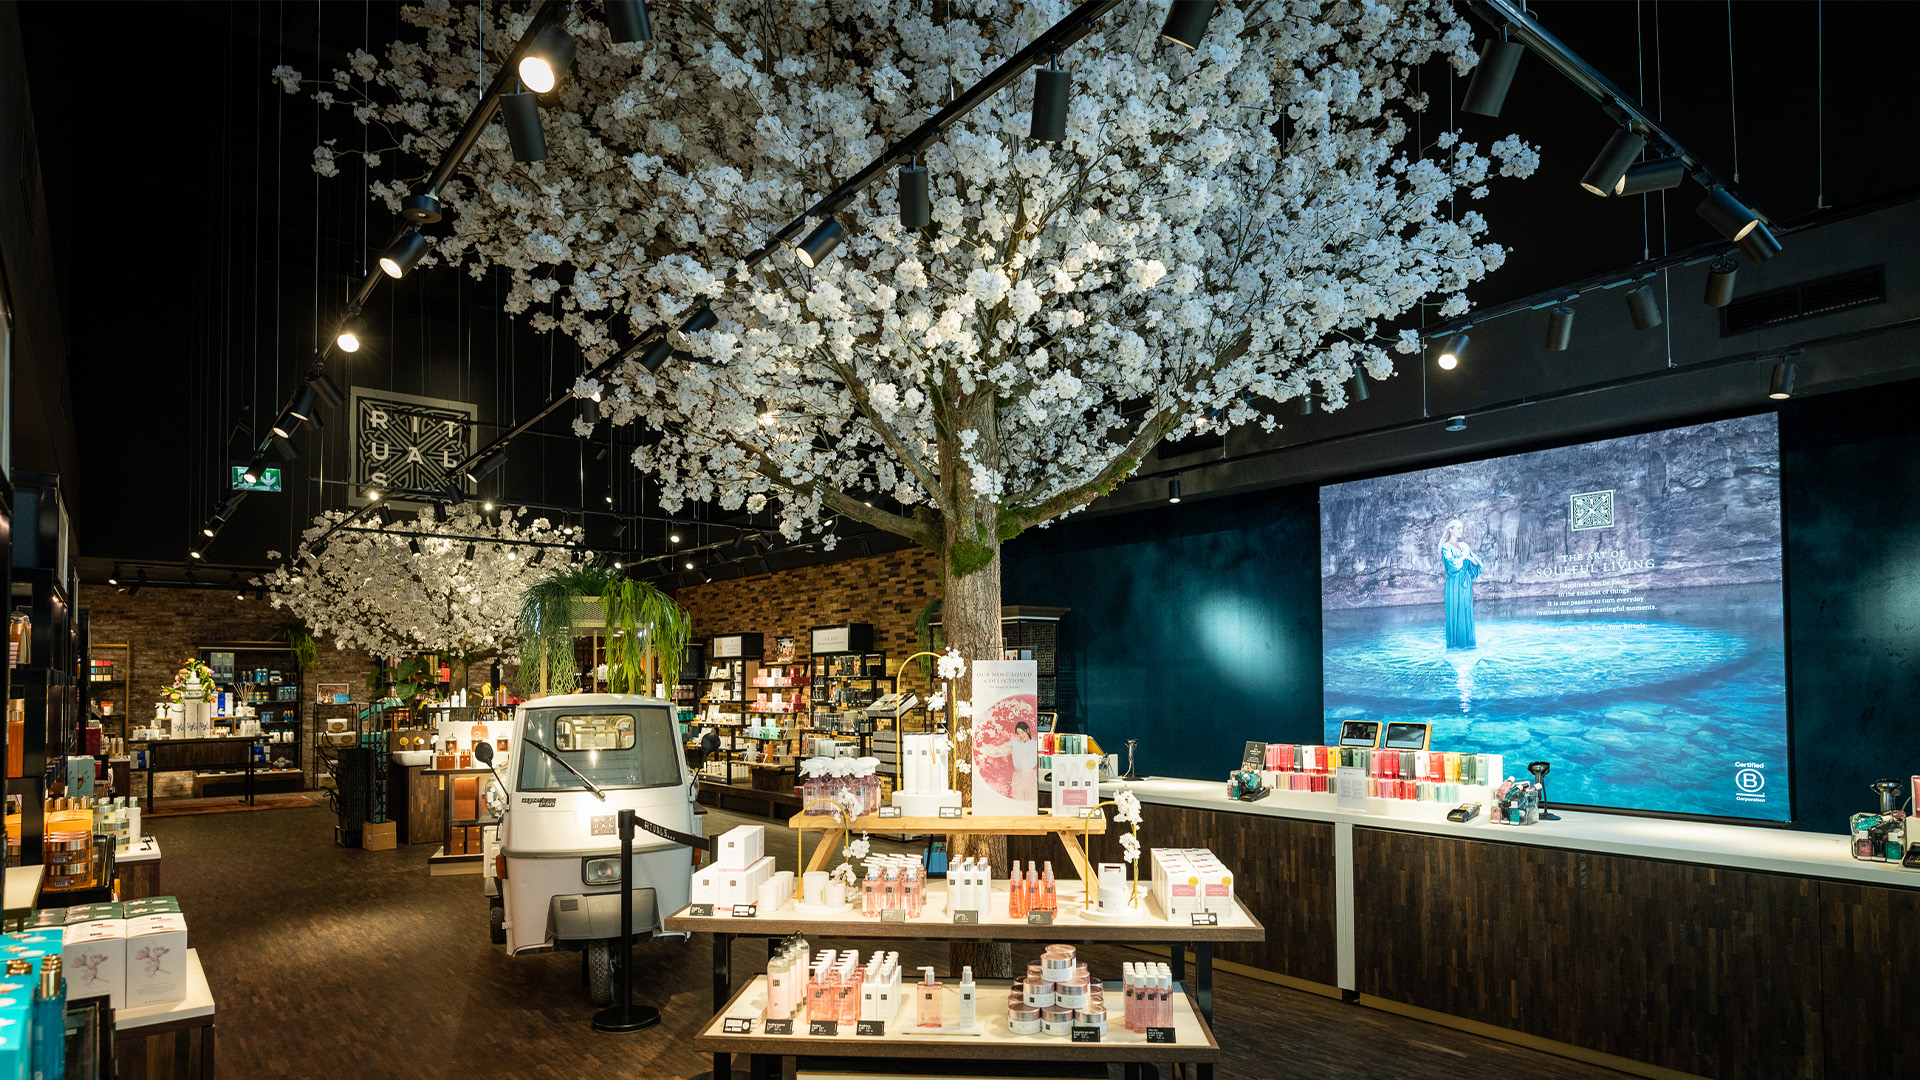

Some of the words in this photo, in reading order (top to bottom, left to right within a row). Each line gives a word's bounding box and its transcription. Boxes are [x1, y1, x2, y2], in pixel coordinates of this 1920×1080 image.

[1562, 554, 1583, 562] THE
[1587, 551, 1607, 560] ART
[1610, 549, 1626, 558] OF
[1536, 563, 1598, 577] SOULFUL
[1603, 558, 1656, 572] LIVING
[1576, 589, 1601, 597] smallest
[1590, 605, 1625, 613] meaningful
[1735, 761, 1765, 769] Certified
